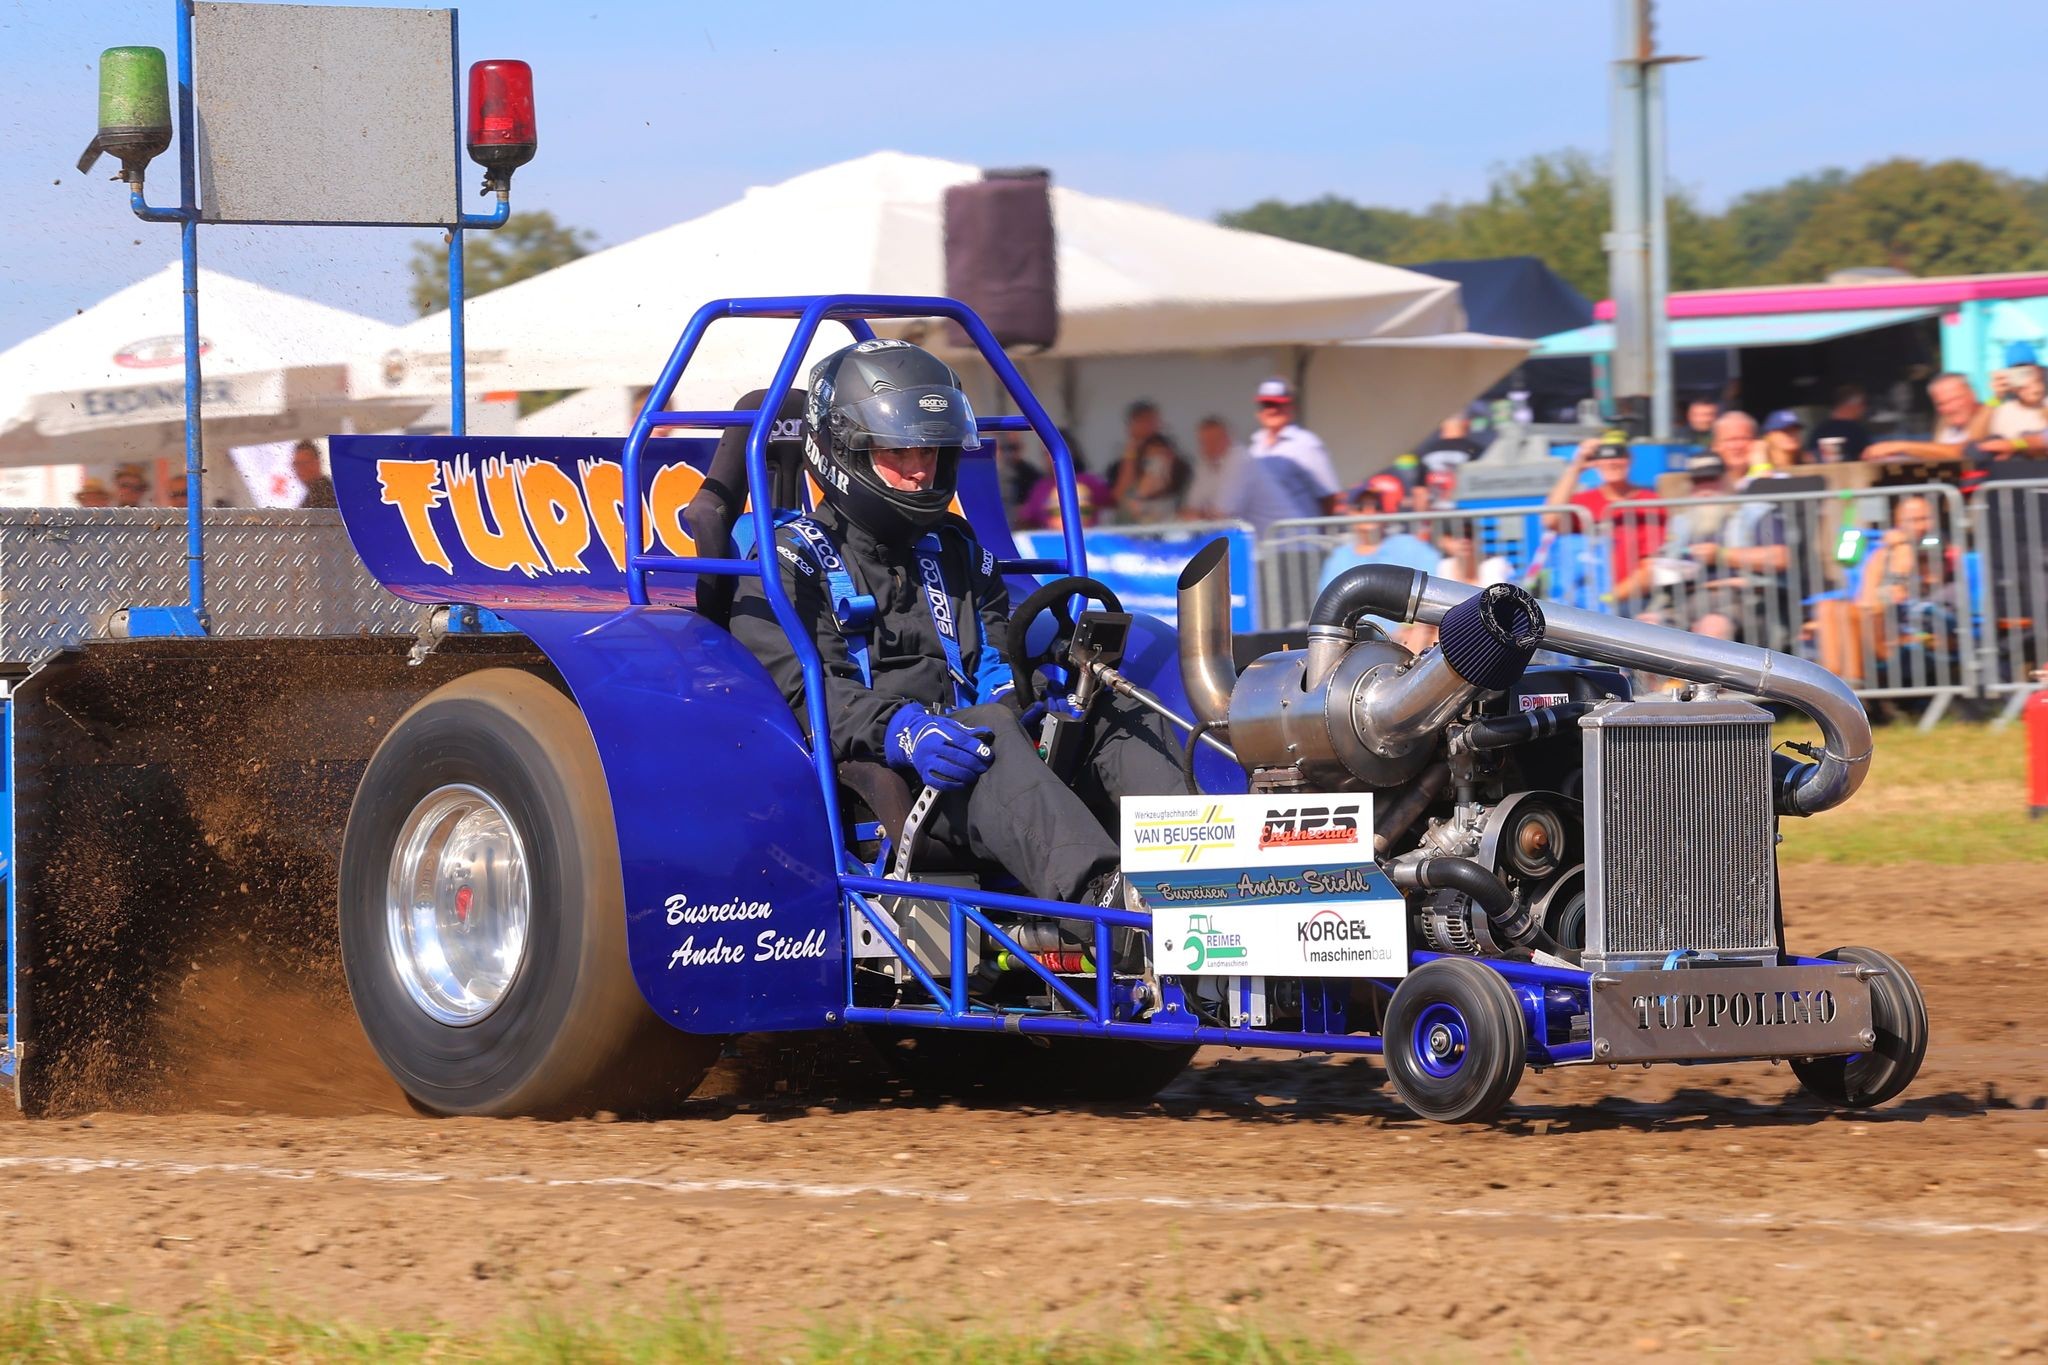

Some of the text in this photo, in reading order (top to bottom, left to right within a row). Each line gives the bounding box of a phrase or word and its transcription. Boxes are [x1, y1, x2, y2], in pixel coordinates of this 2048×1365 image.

[805, 433, 849, 495] EDGAR
[776, 546, 814, 576] sparco
[920, 559, 953, 636] sparco
[1135, 809, 1198, 820] Werkzeugfachhandel
[1266, 806, 1360, 837] MPS
[1134, 825, 1235, 845] VAN BEUSEKOM
[1259, 825, 1358, 845] Engineering
[1156, 869, 1370, 901] Busreisen Andre Stiehl
[664, 893, 773, 926] Busreisen
[668, 928, 827, 970] Andre Stiehl
[1207, 934, 1242, 947] REIMER
[1310, 947, 1392, 962] maschinenbau
[1207, 959, 1249, 968] Landmaschinen
[1632, 989, 1838, 1030] TUPPOLINO
